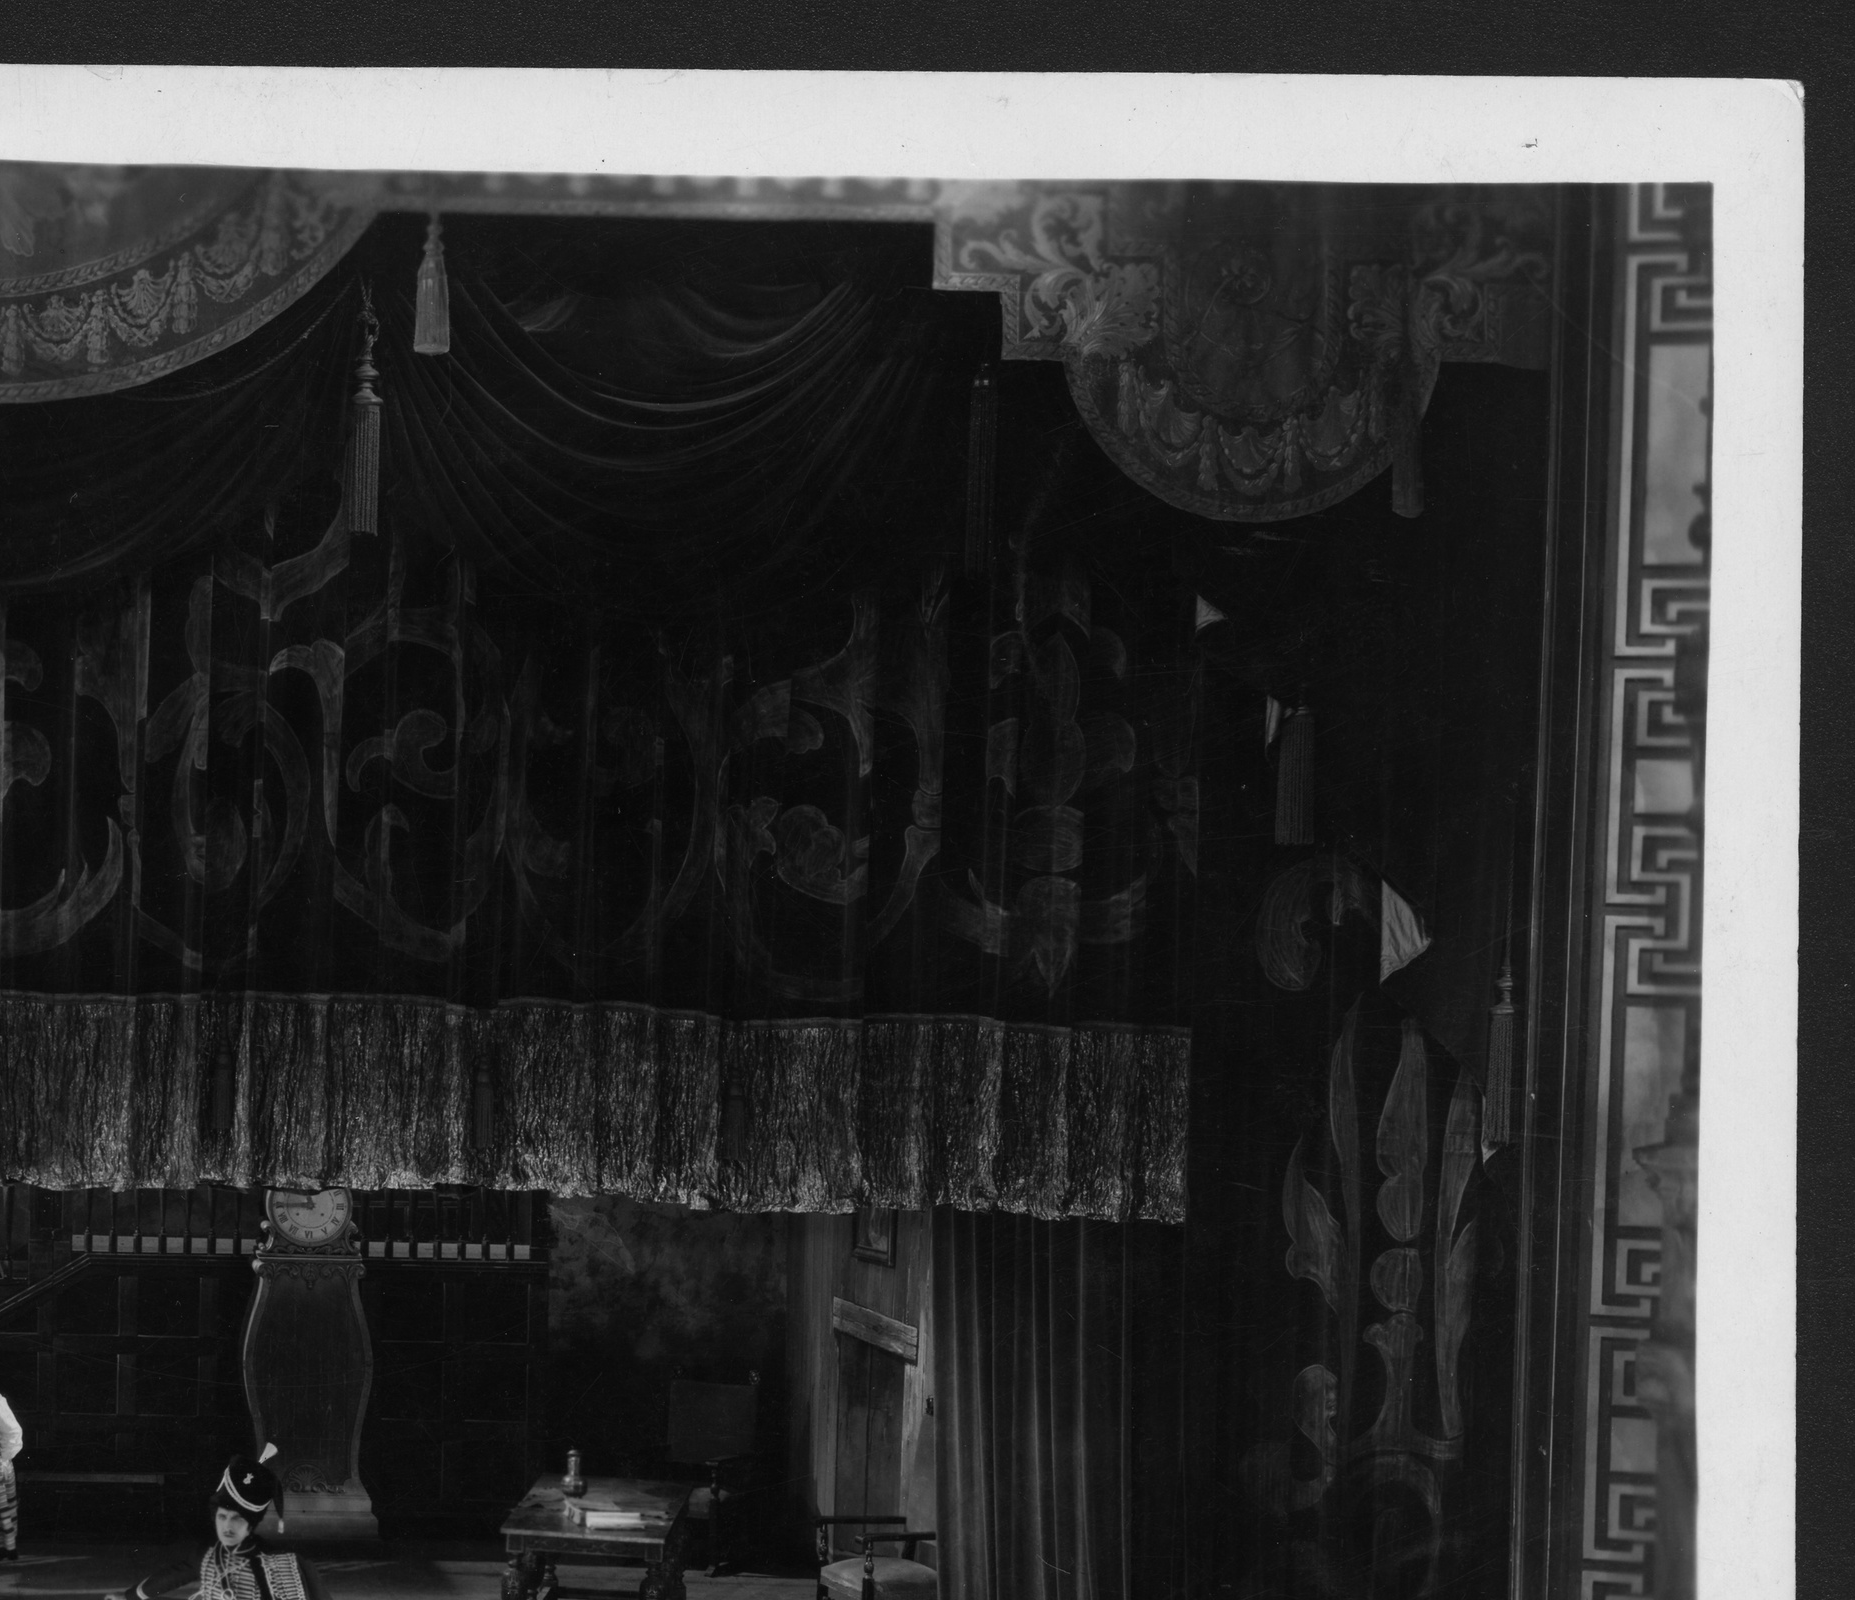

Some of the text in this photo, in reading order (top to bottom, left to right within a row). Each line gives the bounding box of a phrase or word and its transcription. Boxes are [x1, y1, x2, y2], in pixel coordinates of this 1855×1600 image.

[336, 1203, 344, 1211] III
[304, 1230, 313, 1239] VI
[320, 1227, 328, 1235] V
